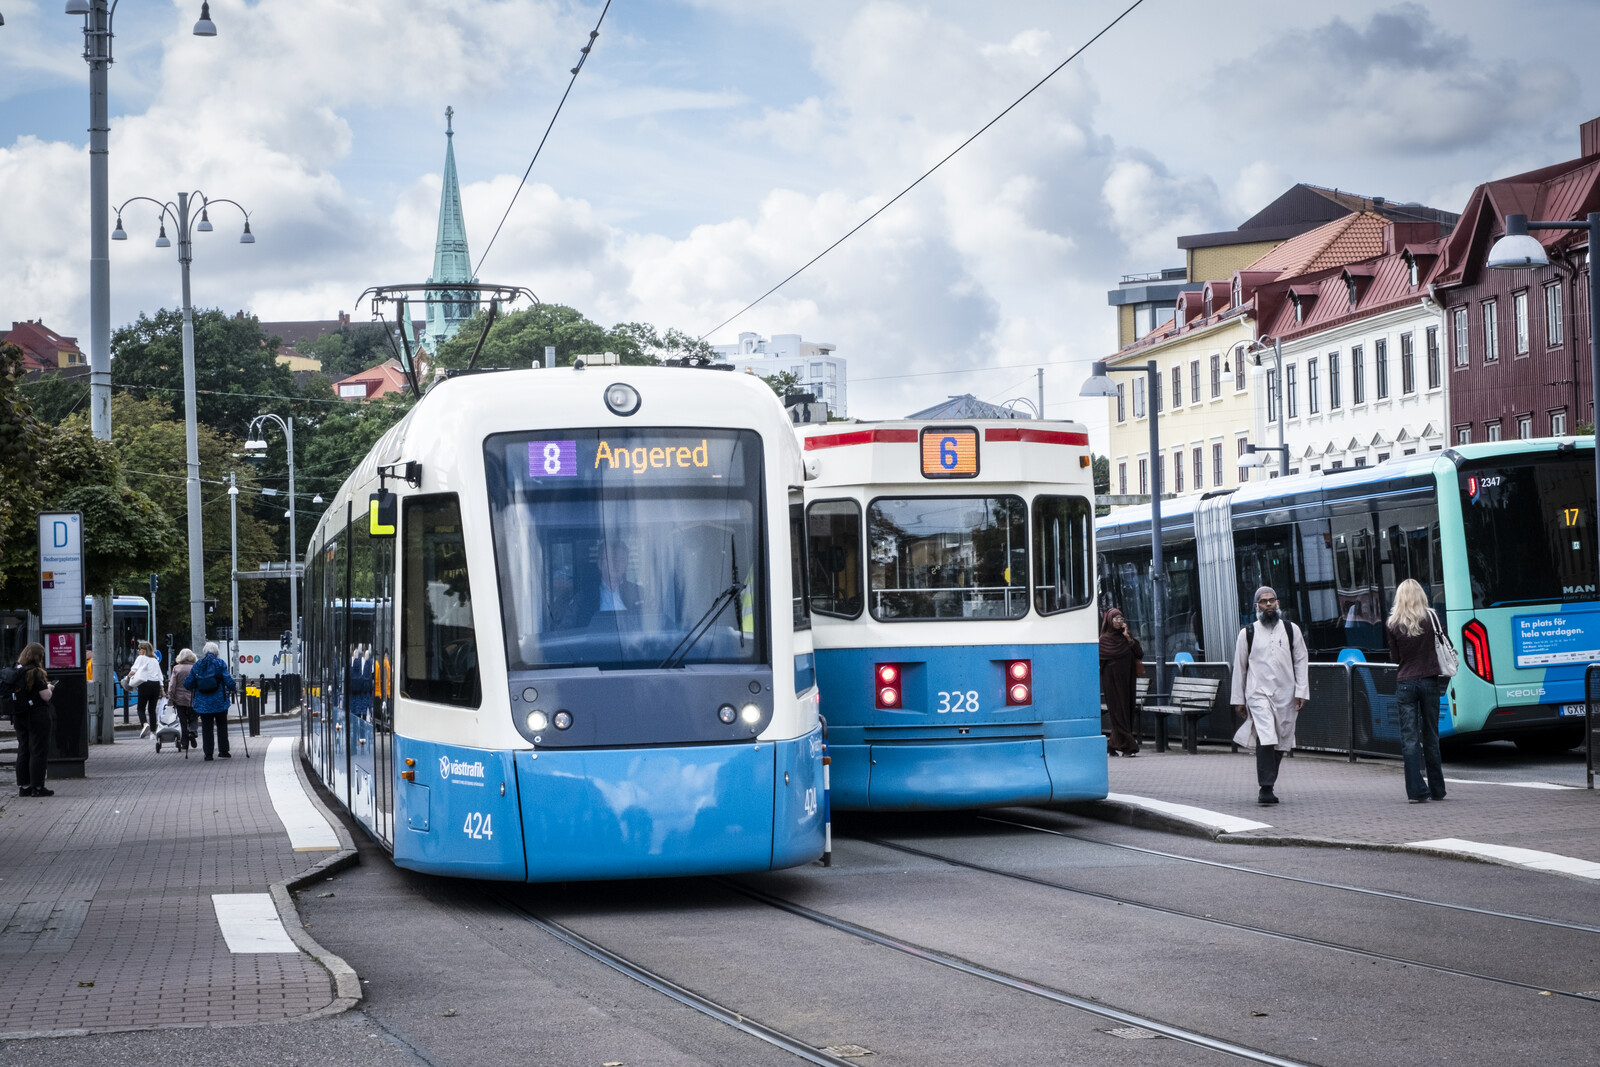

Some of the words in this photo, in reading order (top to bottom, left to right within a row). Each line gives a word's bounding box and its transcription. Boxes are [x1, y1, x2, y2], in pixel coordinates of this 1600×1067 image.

[543, 442, 561, 475] 8
[594, 439, 709, 474] Angered
[940, 436, 958, 470] 6
[1480, 476, 1501, 488] 2347
[1563, 508, 1579, 527] 17
[53, 520, 68, 548] D
[1562, 584, 1596, 594] MAN
[1520, 620, 1531, 629] En
[1532, 618, 1553, 630] plats
[1553, 617, 1567, 626] för
[1521, 629, 1540, 638] hela
[1541, 627, 1585, 637] vardagen.
[937, 690, 980, 714] 328
[450, 759, 485, 778] västtrafik
[804, 786, 818, 816] 424
[463, 811, 493, 841] 424
